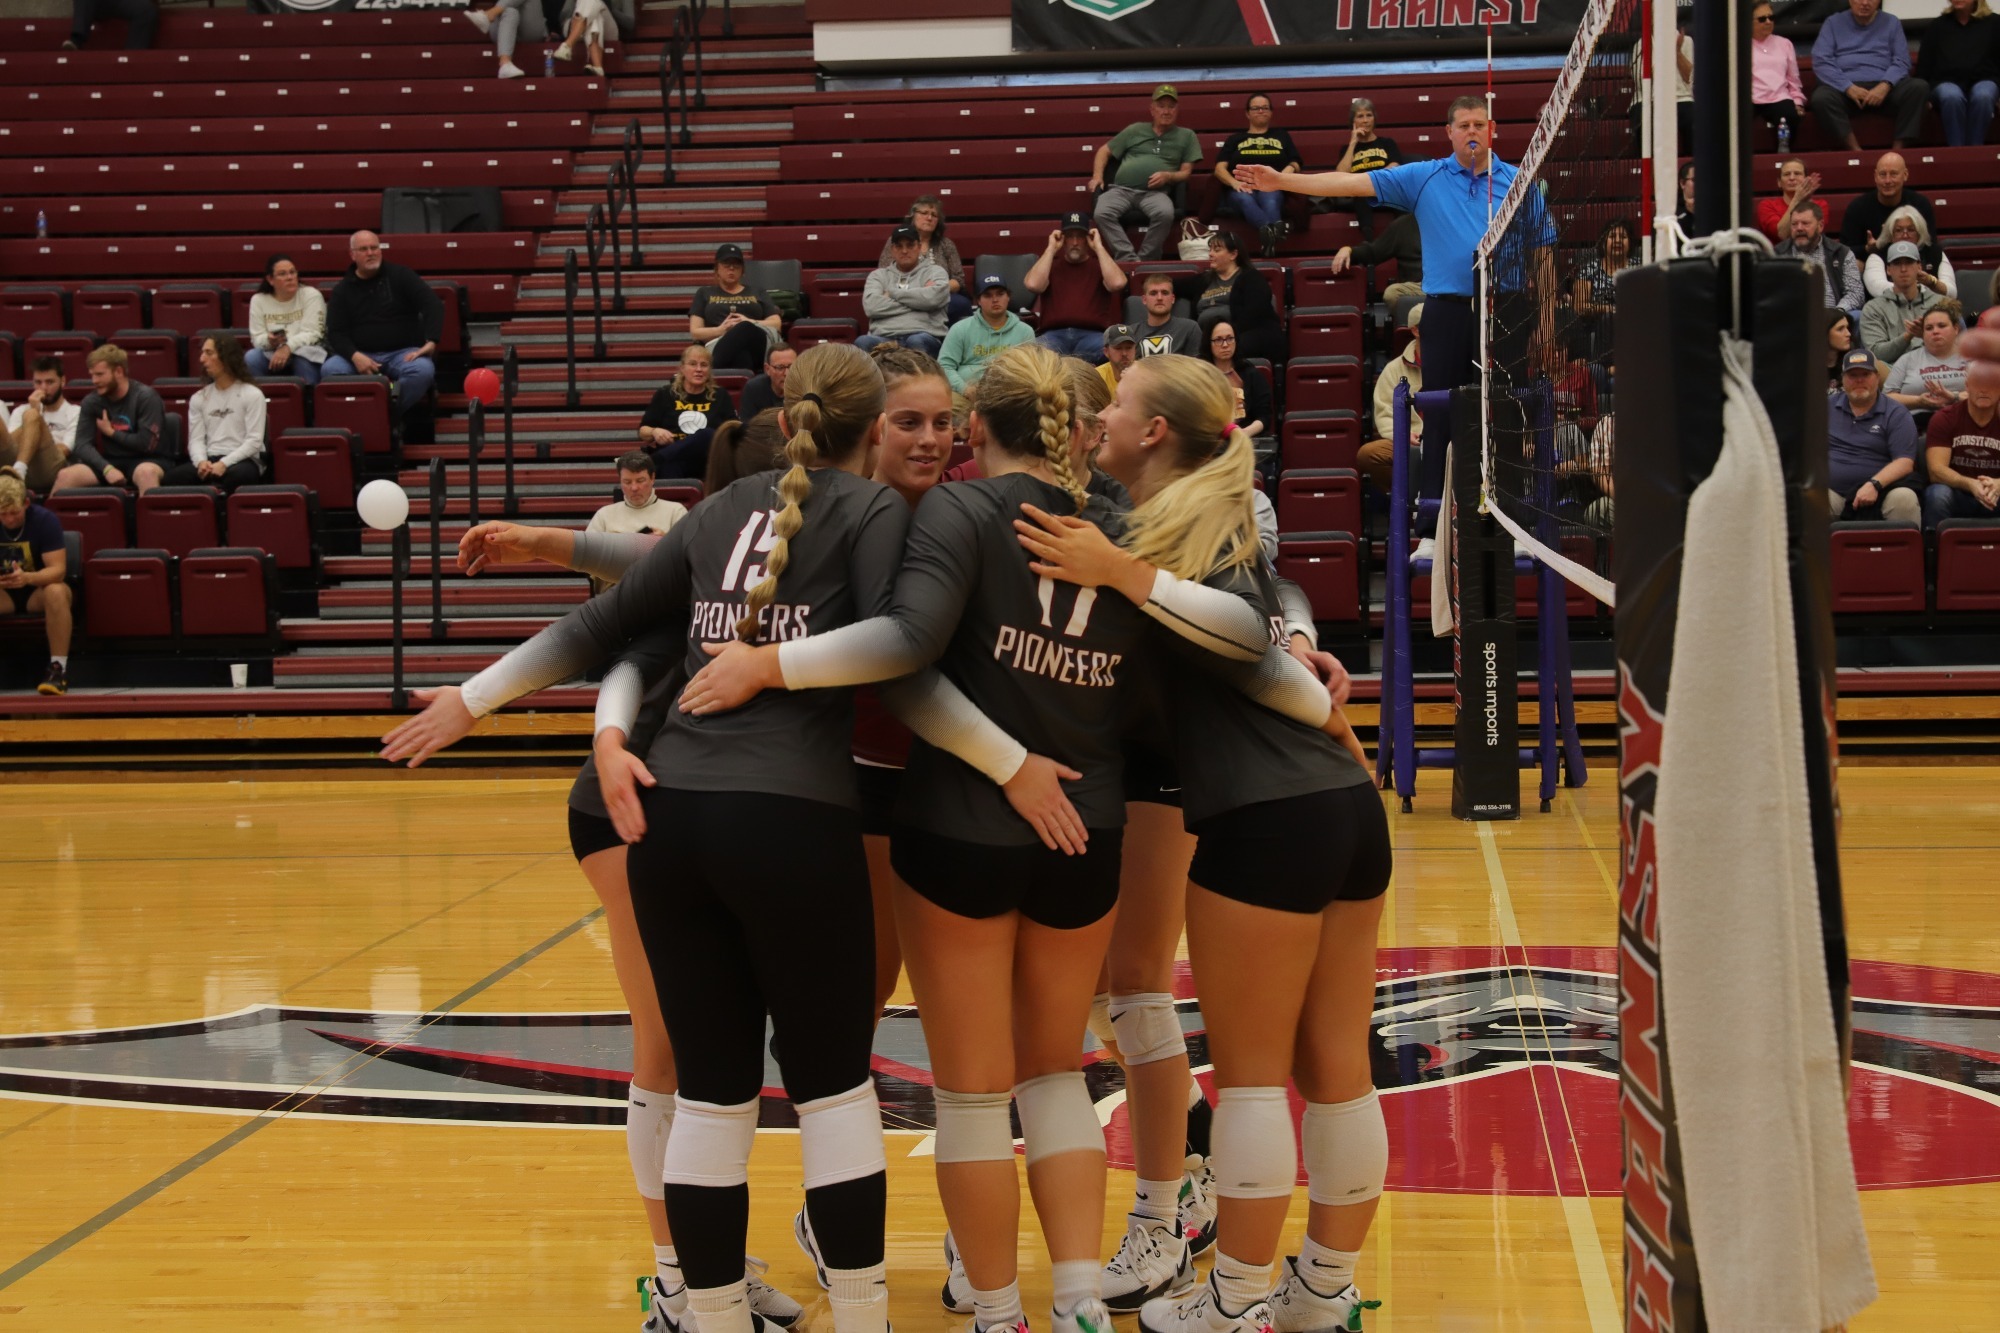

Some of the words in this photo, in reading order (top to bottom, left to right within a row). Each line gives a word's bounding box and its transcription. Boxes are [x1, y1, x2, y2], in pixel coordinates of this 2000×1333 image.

[674, 400, 712, 412] MU
[993, 624, 1123, 687] PIONEERS
[1483, 642, 1498, 688] sports
